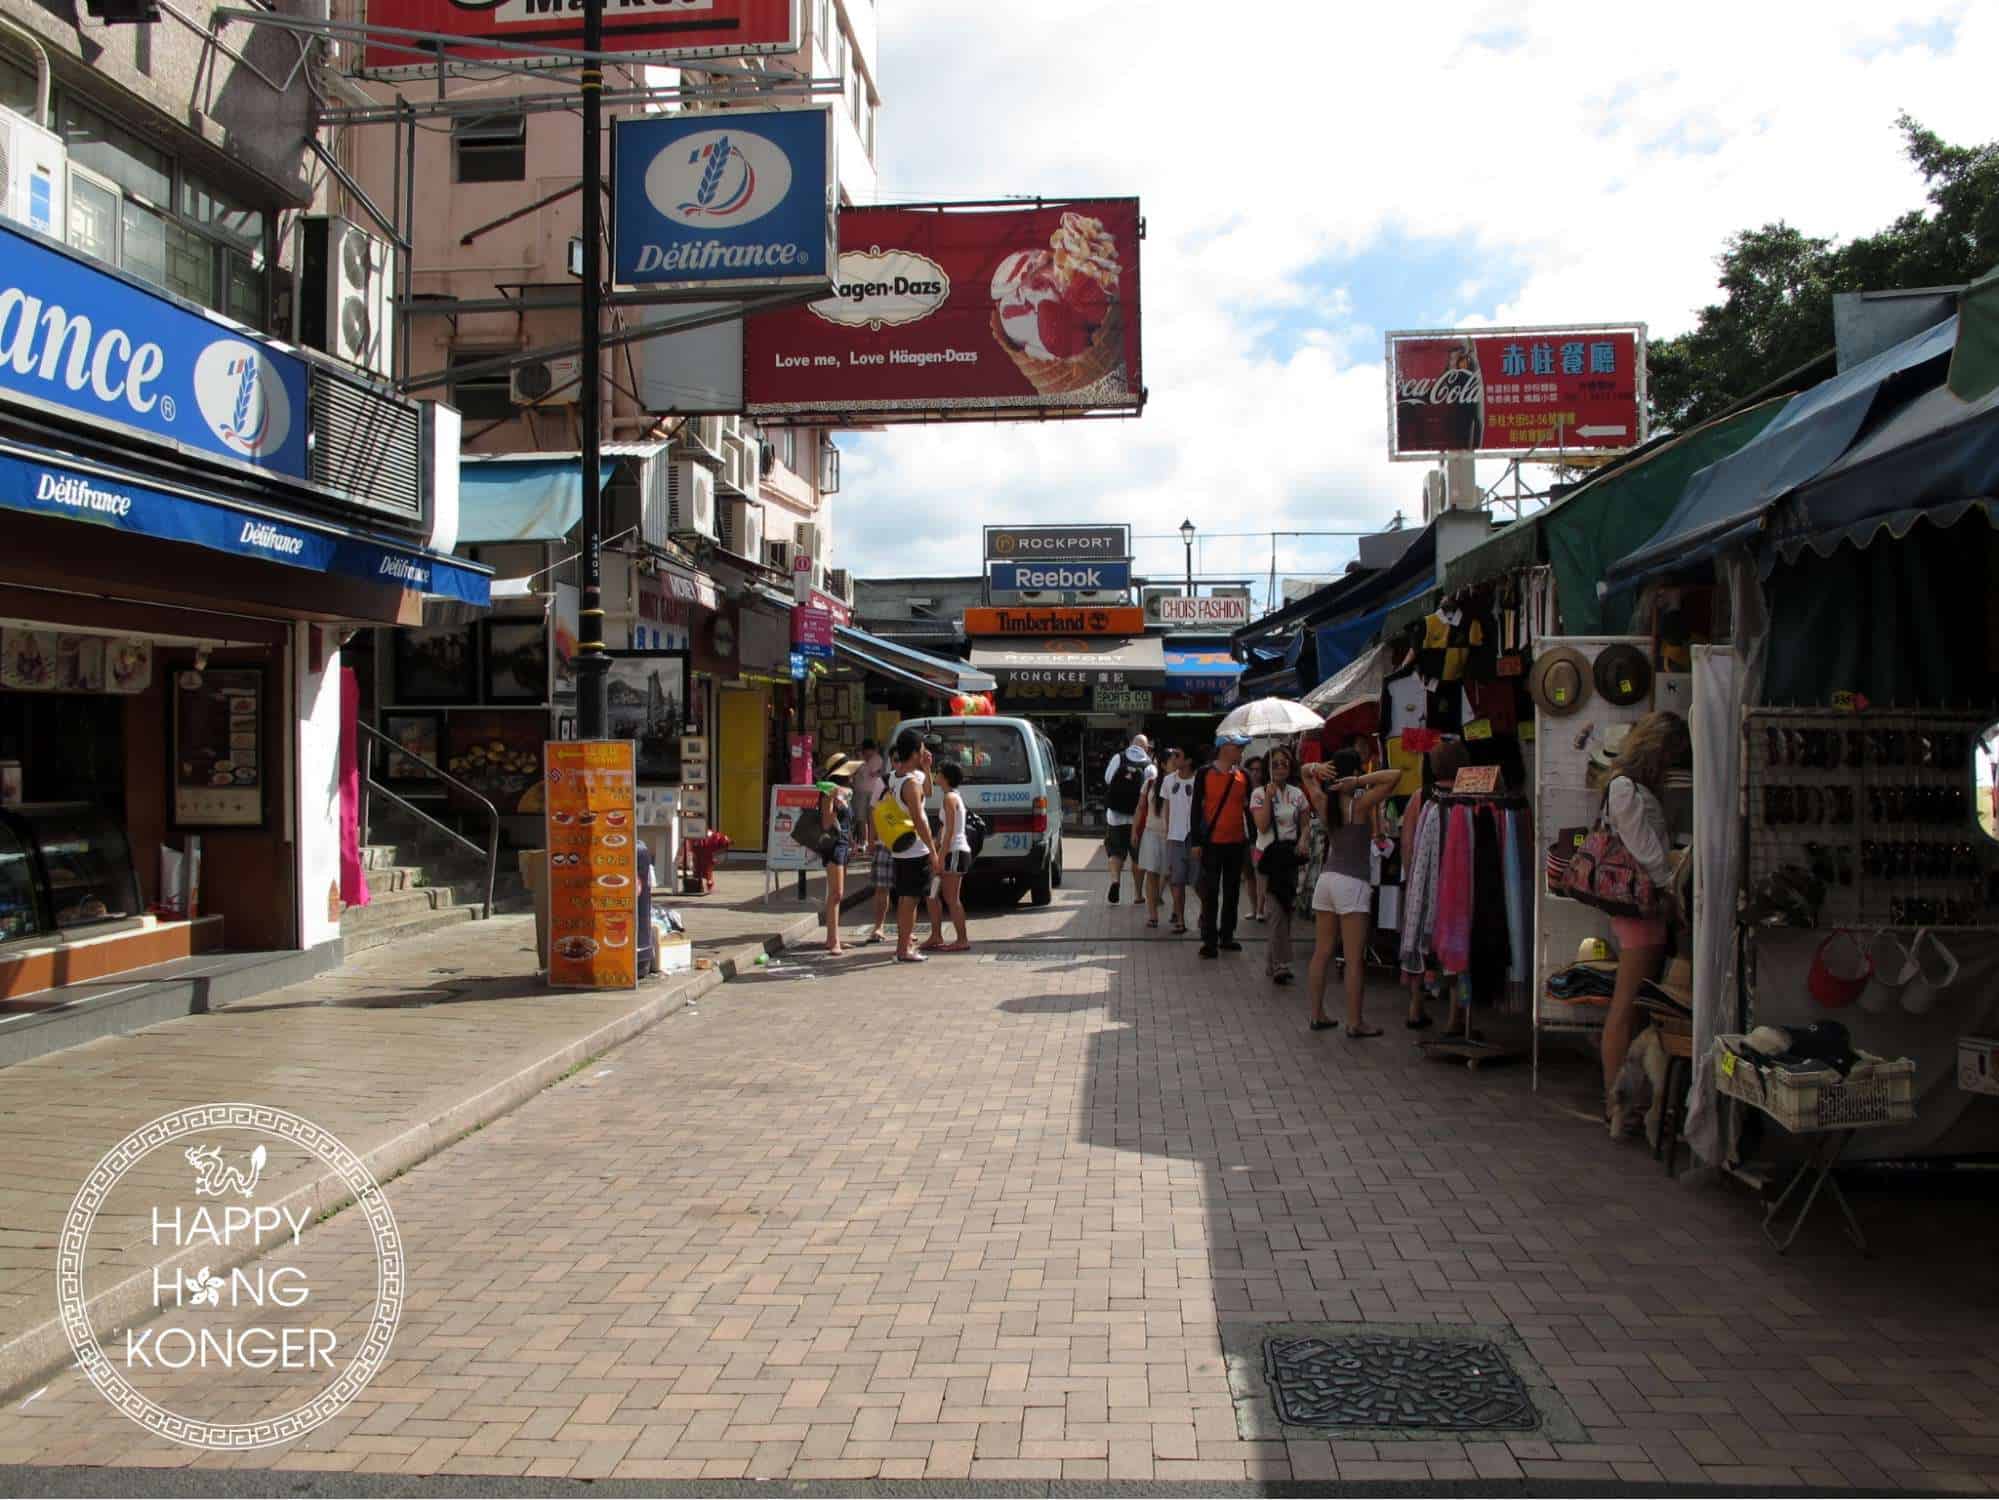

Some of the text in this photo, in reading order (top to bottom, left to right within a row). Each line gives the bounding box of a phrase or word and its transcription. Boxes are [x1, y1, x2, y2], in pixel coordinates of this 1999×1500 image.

[775, 353, 810, 368] Love
[814, 355, 841, 369] me,
[850, 351, 885, 366] Love
[1018, 537, 1113, 549] ROCKPORT
[1015, 568, 1101, 587] Reebok
[1163, 600, 1244, 618] CHOIS FASHION
[996, 611, 1084, 631] Timberland
[1009, 671, 1051, 682] KONG
[1058, 671, 1088, 682] KEE
